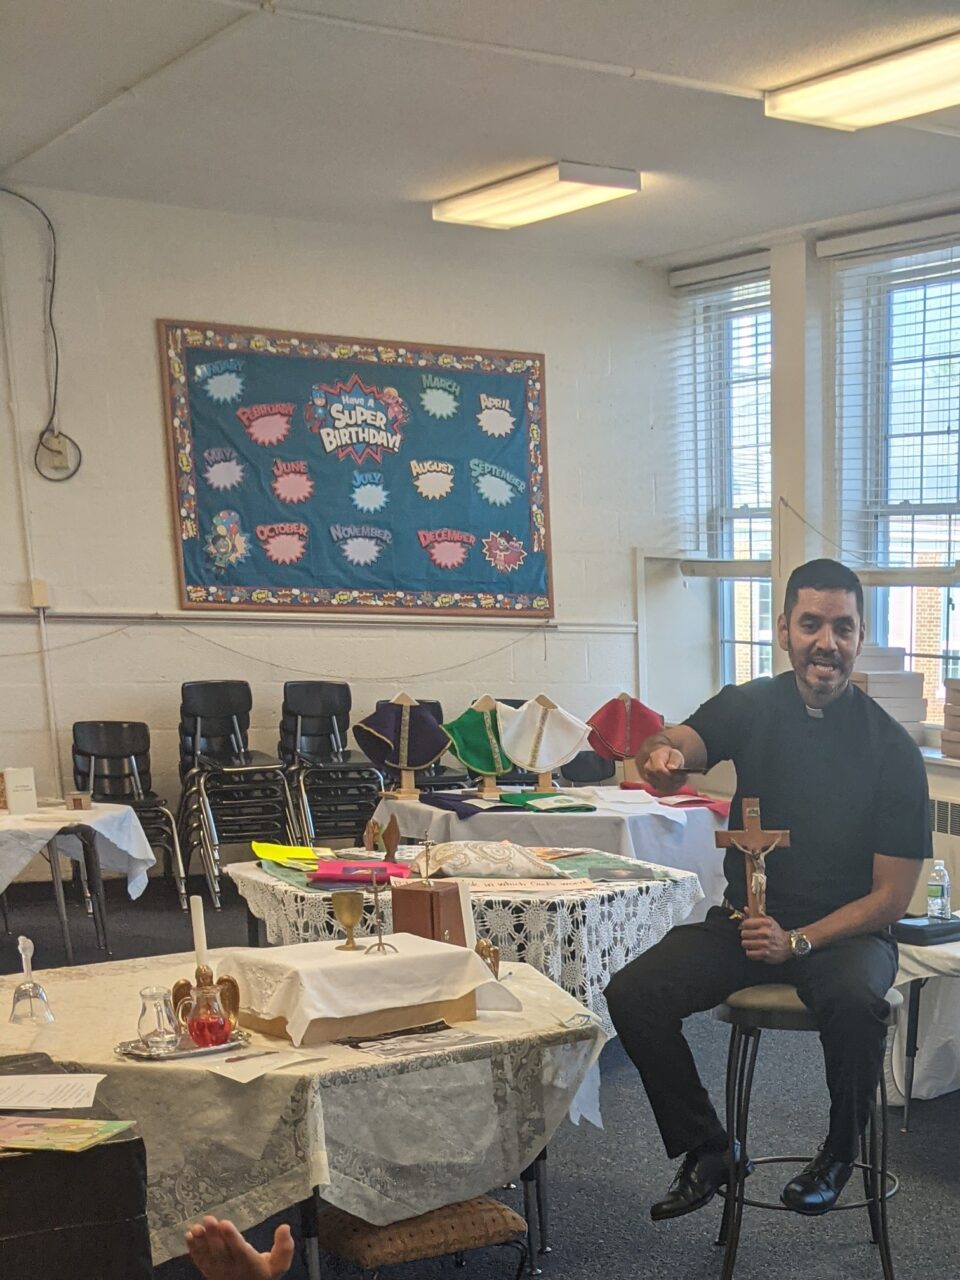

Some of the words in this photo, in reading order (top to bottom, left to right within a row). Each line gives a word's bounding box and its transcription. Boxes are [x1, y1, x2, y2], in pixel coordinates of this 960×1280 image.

[421, 374, 461, 396] MARCH
[367, 398, 375, 408] A
[480, 393, 512, 412] APRIL
[236, 402, 296, 428] FEBRUARY
[330, 403, 387, 430] SUPER
[320, 427, 402, 453] BIRTHDAY!
[203, 447, 238, 466] MAY
[273, 458, 309, 477] JUNE
[410, 459, 455, 477] AUGUST
[469, 458, 526, 493] SEPTEMBER
[352, 470, 383, 487] JULY
[255, 523, 309, 541] OCTOBER
[329, 524, 393, 545] NOVEMBER
[416, 528, 477, 548] DECEMBER
